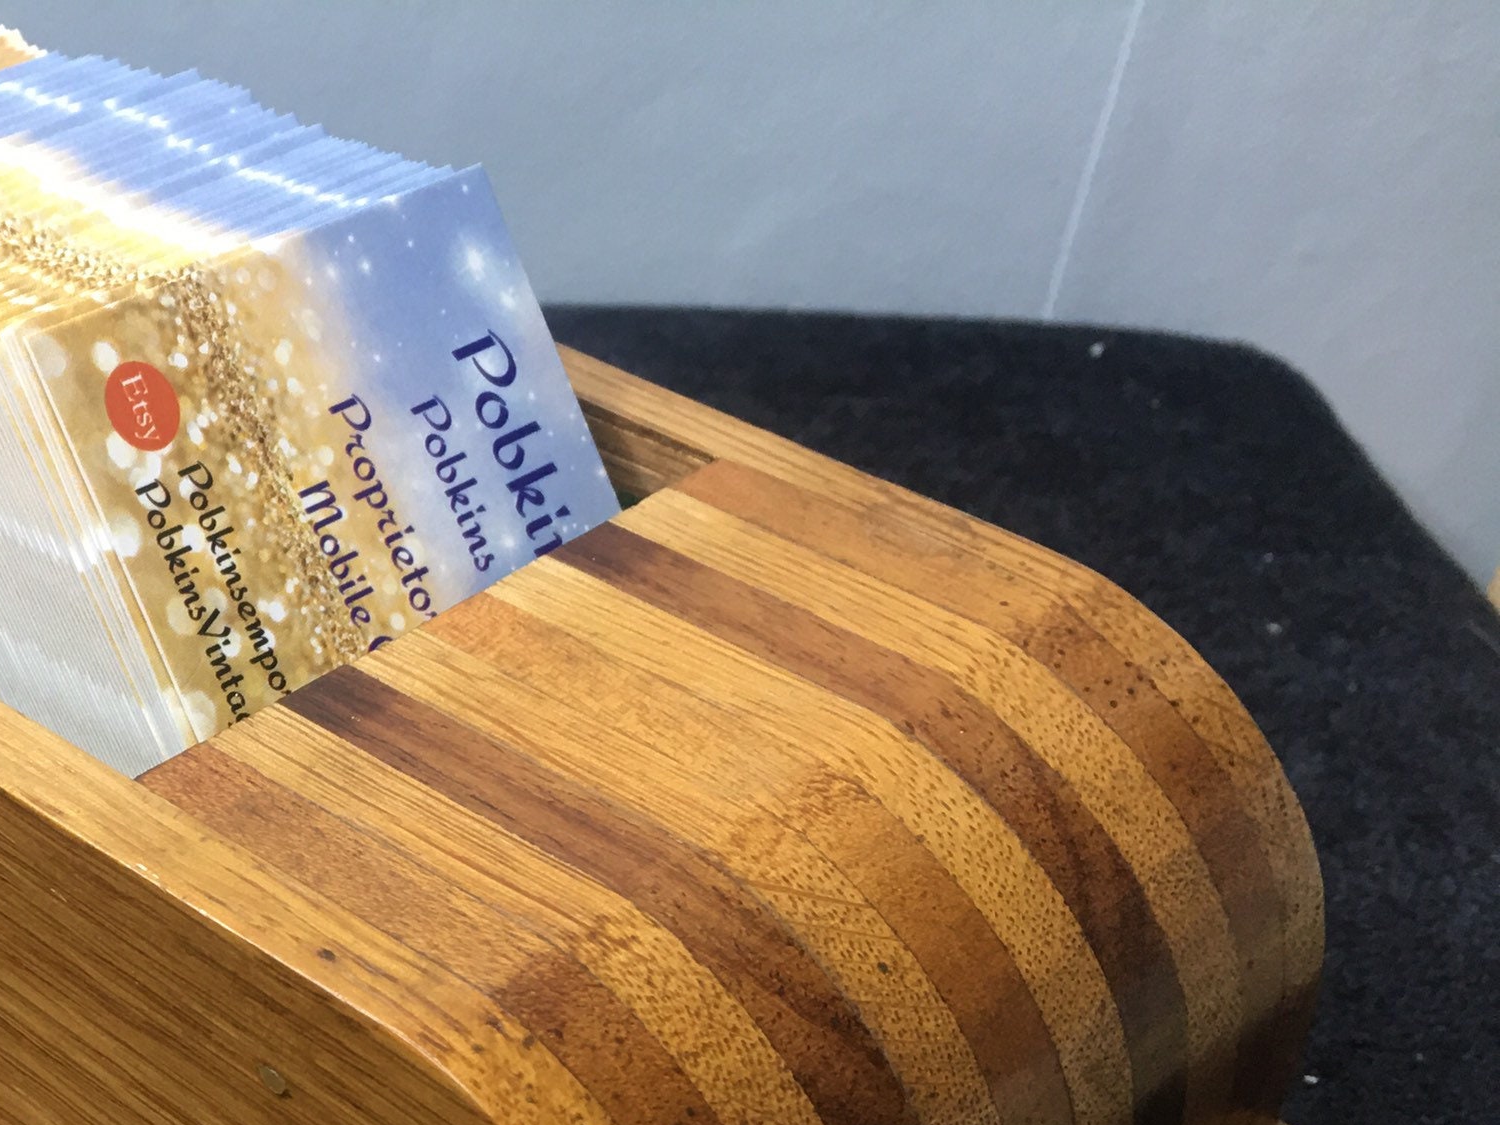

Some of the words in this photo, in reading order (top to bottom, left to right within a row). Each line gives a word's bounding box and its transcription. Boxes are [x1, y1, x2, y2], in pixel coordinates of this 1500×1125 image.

[120, 371, 160, 440] Etsy
[410, 394, 495, 572] Pobkins
[177, 460, 292, 695] Pobkinsempo
[297, 479, 375, 628] Mobile
[327, 393, 438, 618] Proprieto
